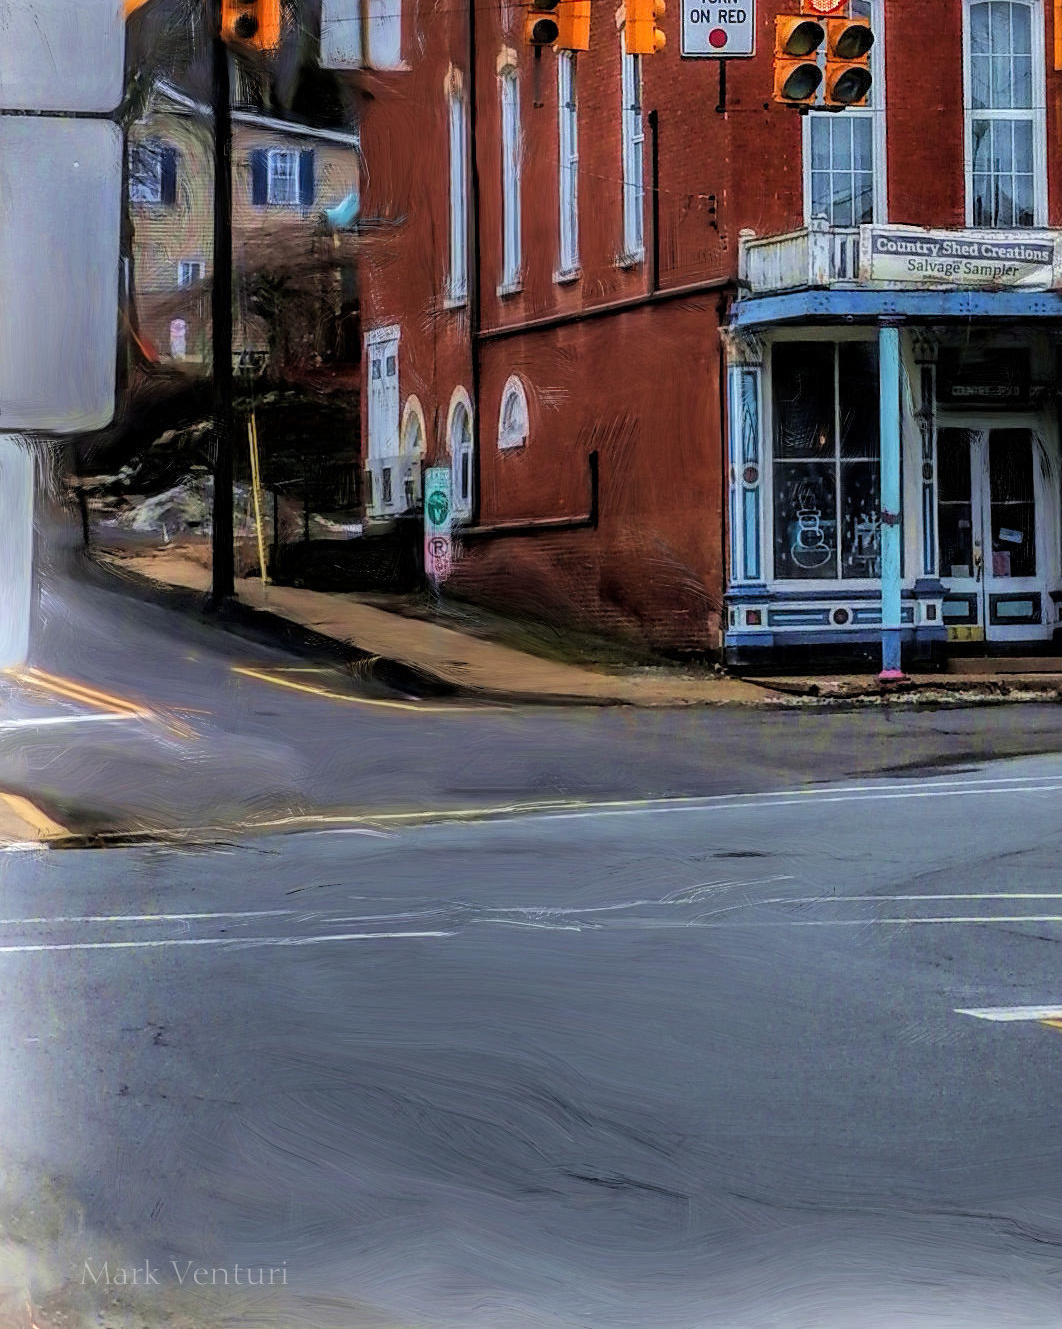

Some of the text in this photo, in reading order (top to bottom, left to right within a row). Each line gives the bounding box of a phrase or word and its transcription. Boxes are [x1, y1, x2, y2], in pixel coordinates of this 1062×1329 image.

[690, 9, 747, 24] ON RED
[876, 237, 1050, 262] Country Shed Creations
[907, 258, 961, 276] Salvage
[963, 261, 1020, 279] Sampler
